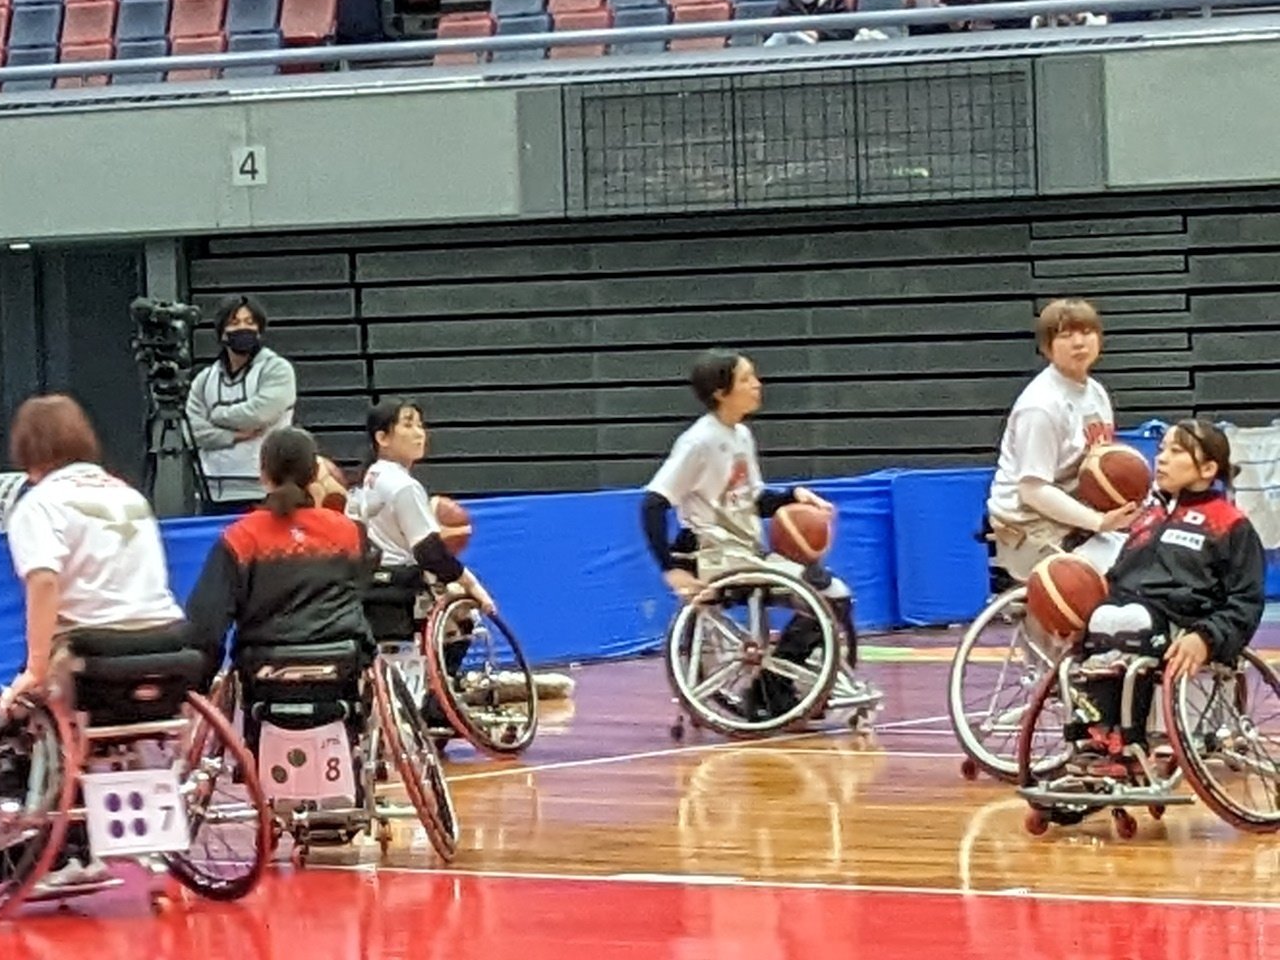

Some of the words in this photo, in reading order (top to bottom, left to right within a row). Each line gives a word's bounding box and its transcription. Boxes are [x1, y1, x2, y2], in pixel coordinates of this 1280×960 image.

[238, 151, 258, 181] 4
[326, 757, 340, 782] 8
[160, 805, 175, 831] 7
